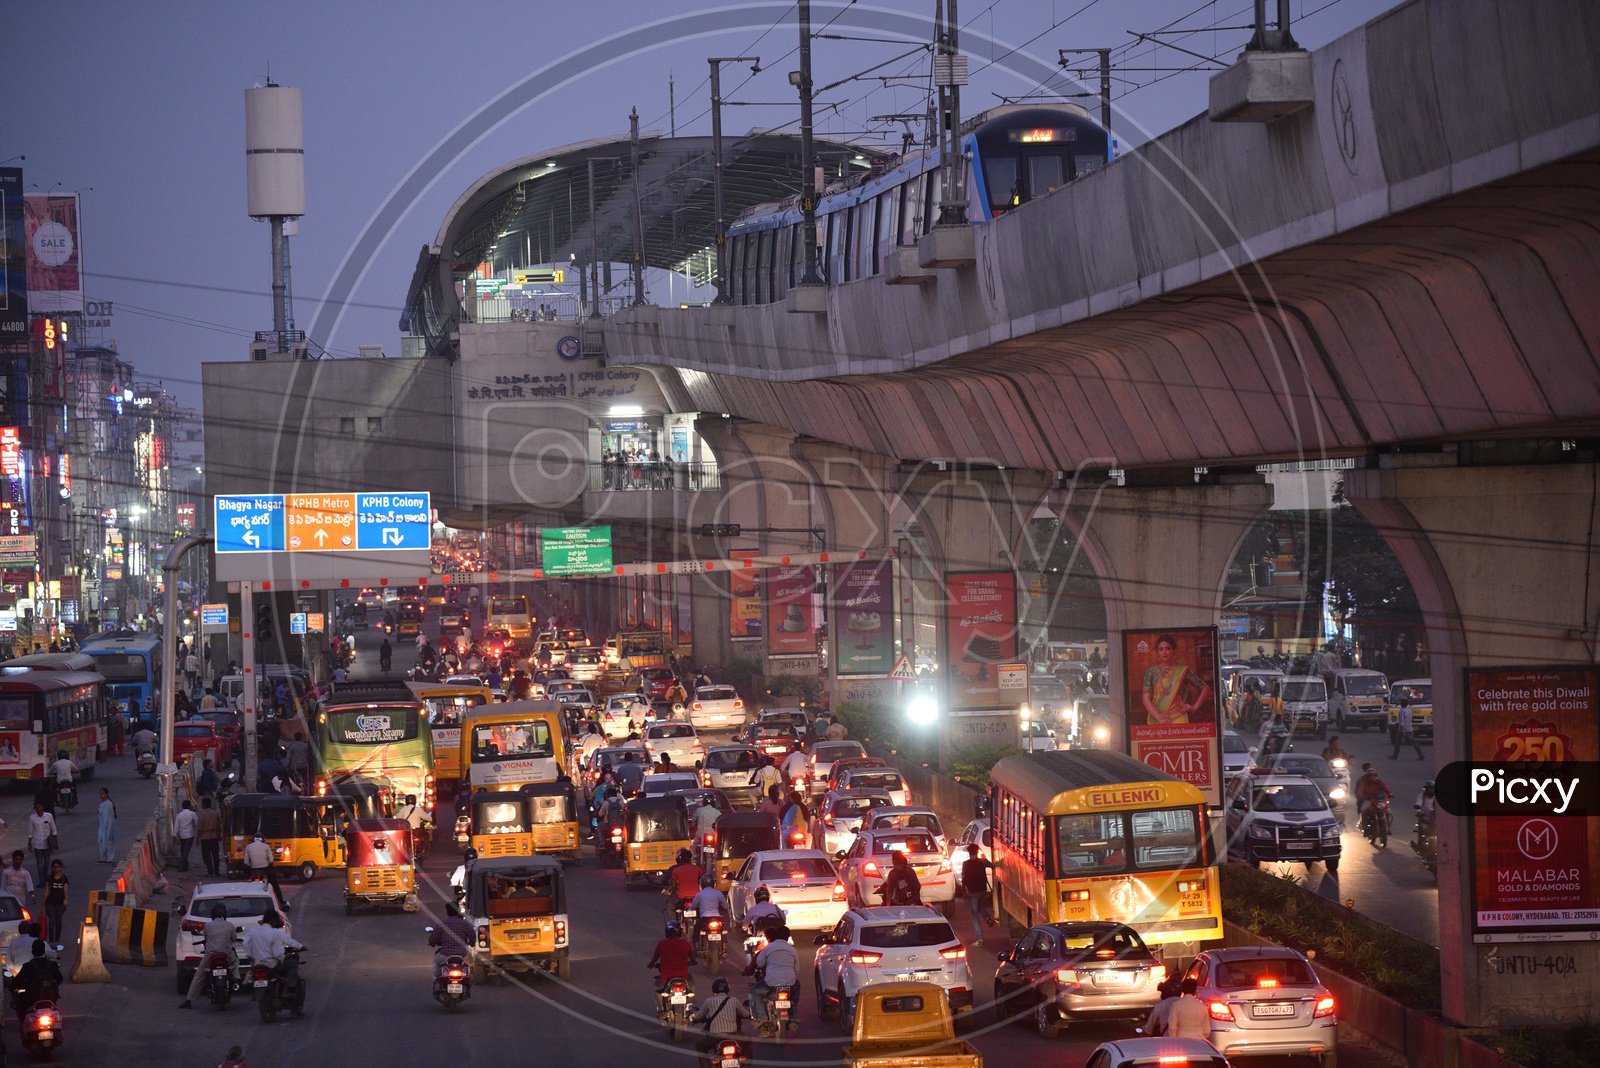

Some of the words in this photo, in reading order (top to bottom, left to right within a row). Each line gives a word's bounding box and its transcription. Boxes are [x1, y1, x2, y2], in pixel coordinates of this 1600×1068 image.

[41, 239, 66, 248] SALE
[578, 372, 604, 382] KPHB
[607, 370, 640, 382] Colony
[219, 500, 252, 512] Bhagya
[254, 499, 282, 512] Nagar
[292, 498, 320, 508] KPHB
[323, 498, 350, 508] Metro
[362, 496, 390, 508] KPHB
[392, 496, 424, 508] Colony
[856, 596, 880, 604] Bakers
[972, 614, 1002, 624] Bakers
[1478, 689, 1530, 700] Celebrate
[1534, 688, 1553, 698] this
[1556, 687, 1590, 698] Diwali
[1480, 701, 1504, 712] with
[1507, 701, 1528, 711] free
[1532, 700, 1556, 712] gold
[1560, 700, 1588, 710] coins
[344, 730, 381, 739] Veerabhadra
[383, 730, 404, 738] Swamy
[1504, 736, 1564, 770] 250
[1144, 750, 1206, 772] CMR
[1092, 790, 1160, 805] ELLENKI
[1498, 869, 1580, 882] MALABAR
[1533, 883, 1580, 892] DIAMONDS
[1502, 913, 1524, 922] COLONY,
[1526, 912, 1560, 920] HYDERABAD.
[1562, 911, 1573, 919] TEL:
